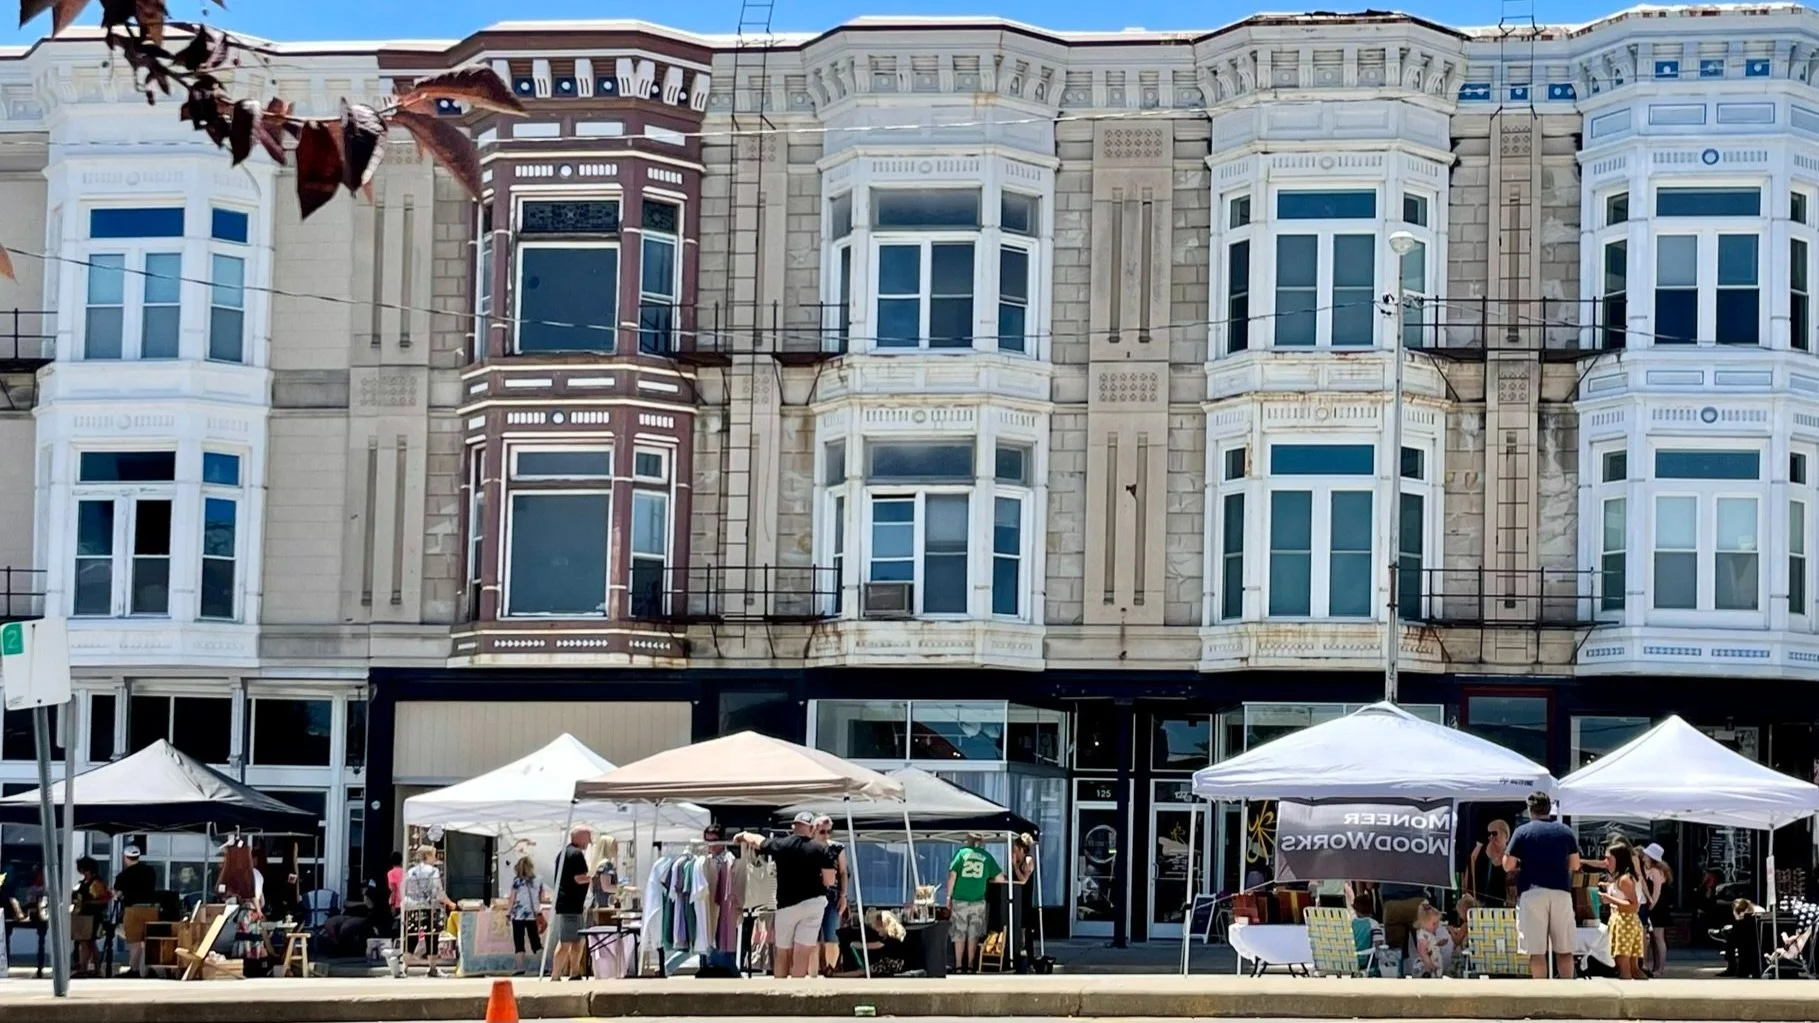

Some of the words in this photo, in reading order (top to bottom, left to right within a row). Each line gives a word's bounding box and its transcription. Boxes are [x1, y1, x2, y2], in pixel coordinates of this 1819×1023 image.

[6, 629, 18, 649] 2
[1096, 789, 1112, 798] 125
[961, 860, 985, 878] 29
